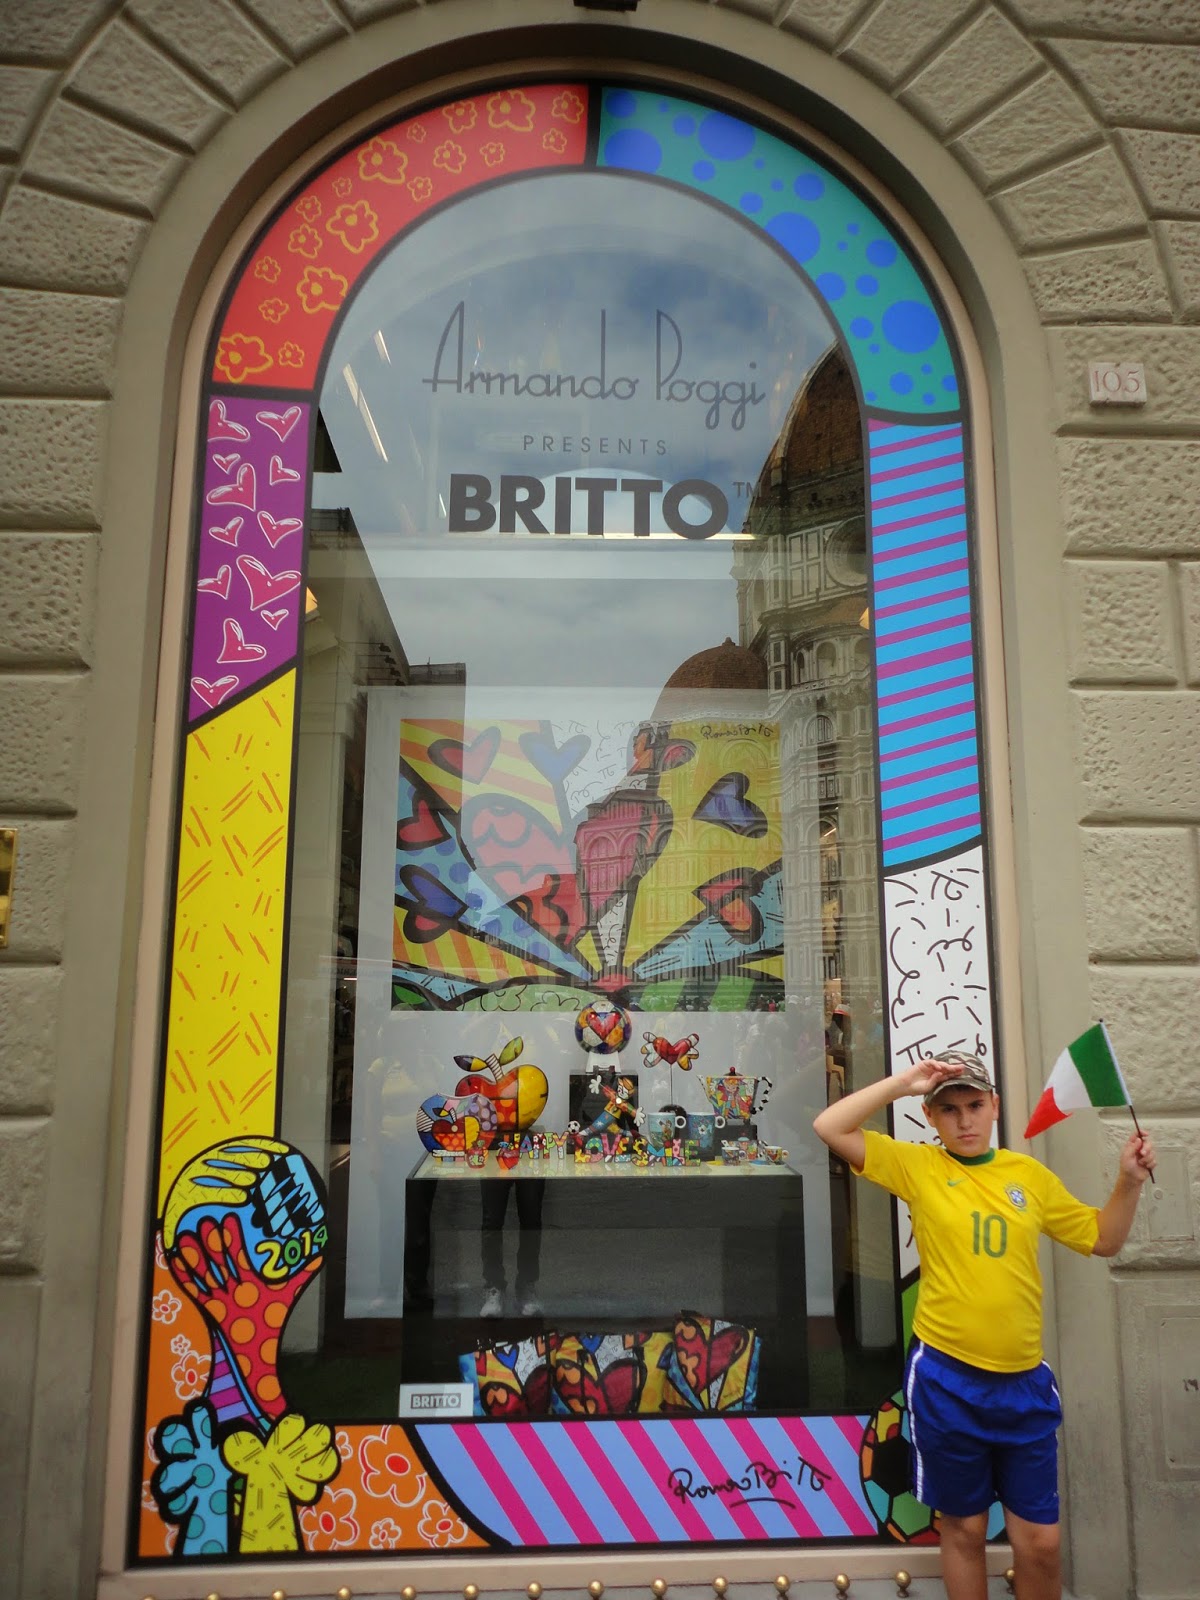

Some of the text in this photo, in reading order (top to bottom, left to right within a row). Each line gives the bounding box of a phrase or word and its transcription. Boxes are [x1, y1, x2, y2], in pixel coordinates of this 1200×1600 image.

[422, 300, 766, 431] Armando Poggi
[1093, 368, 1140, 393] 105
[522, 434, 667, 455] PRESENTS
[449, 472, 729, 540] BRITTO
[256, 1224, 329, 1280] 2014
[971, 1210, 1008, 1258] 10
[411, 1394, 461, 1408] BRITTO
